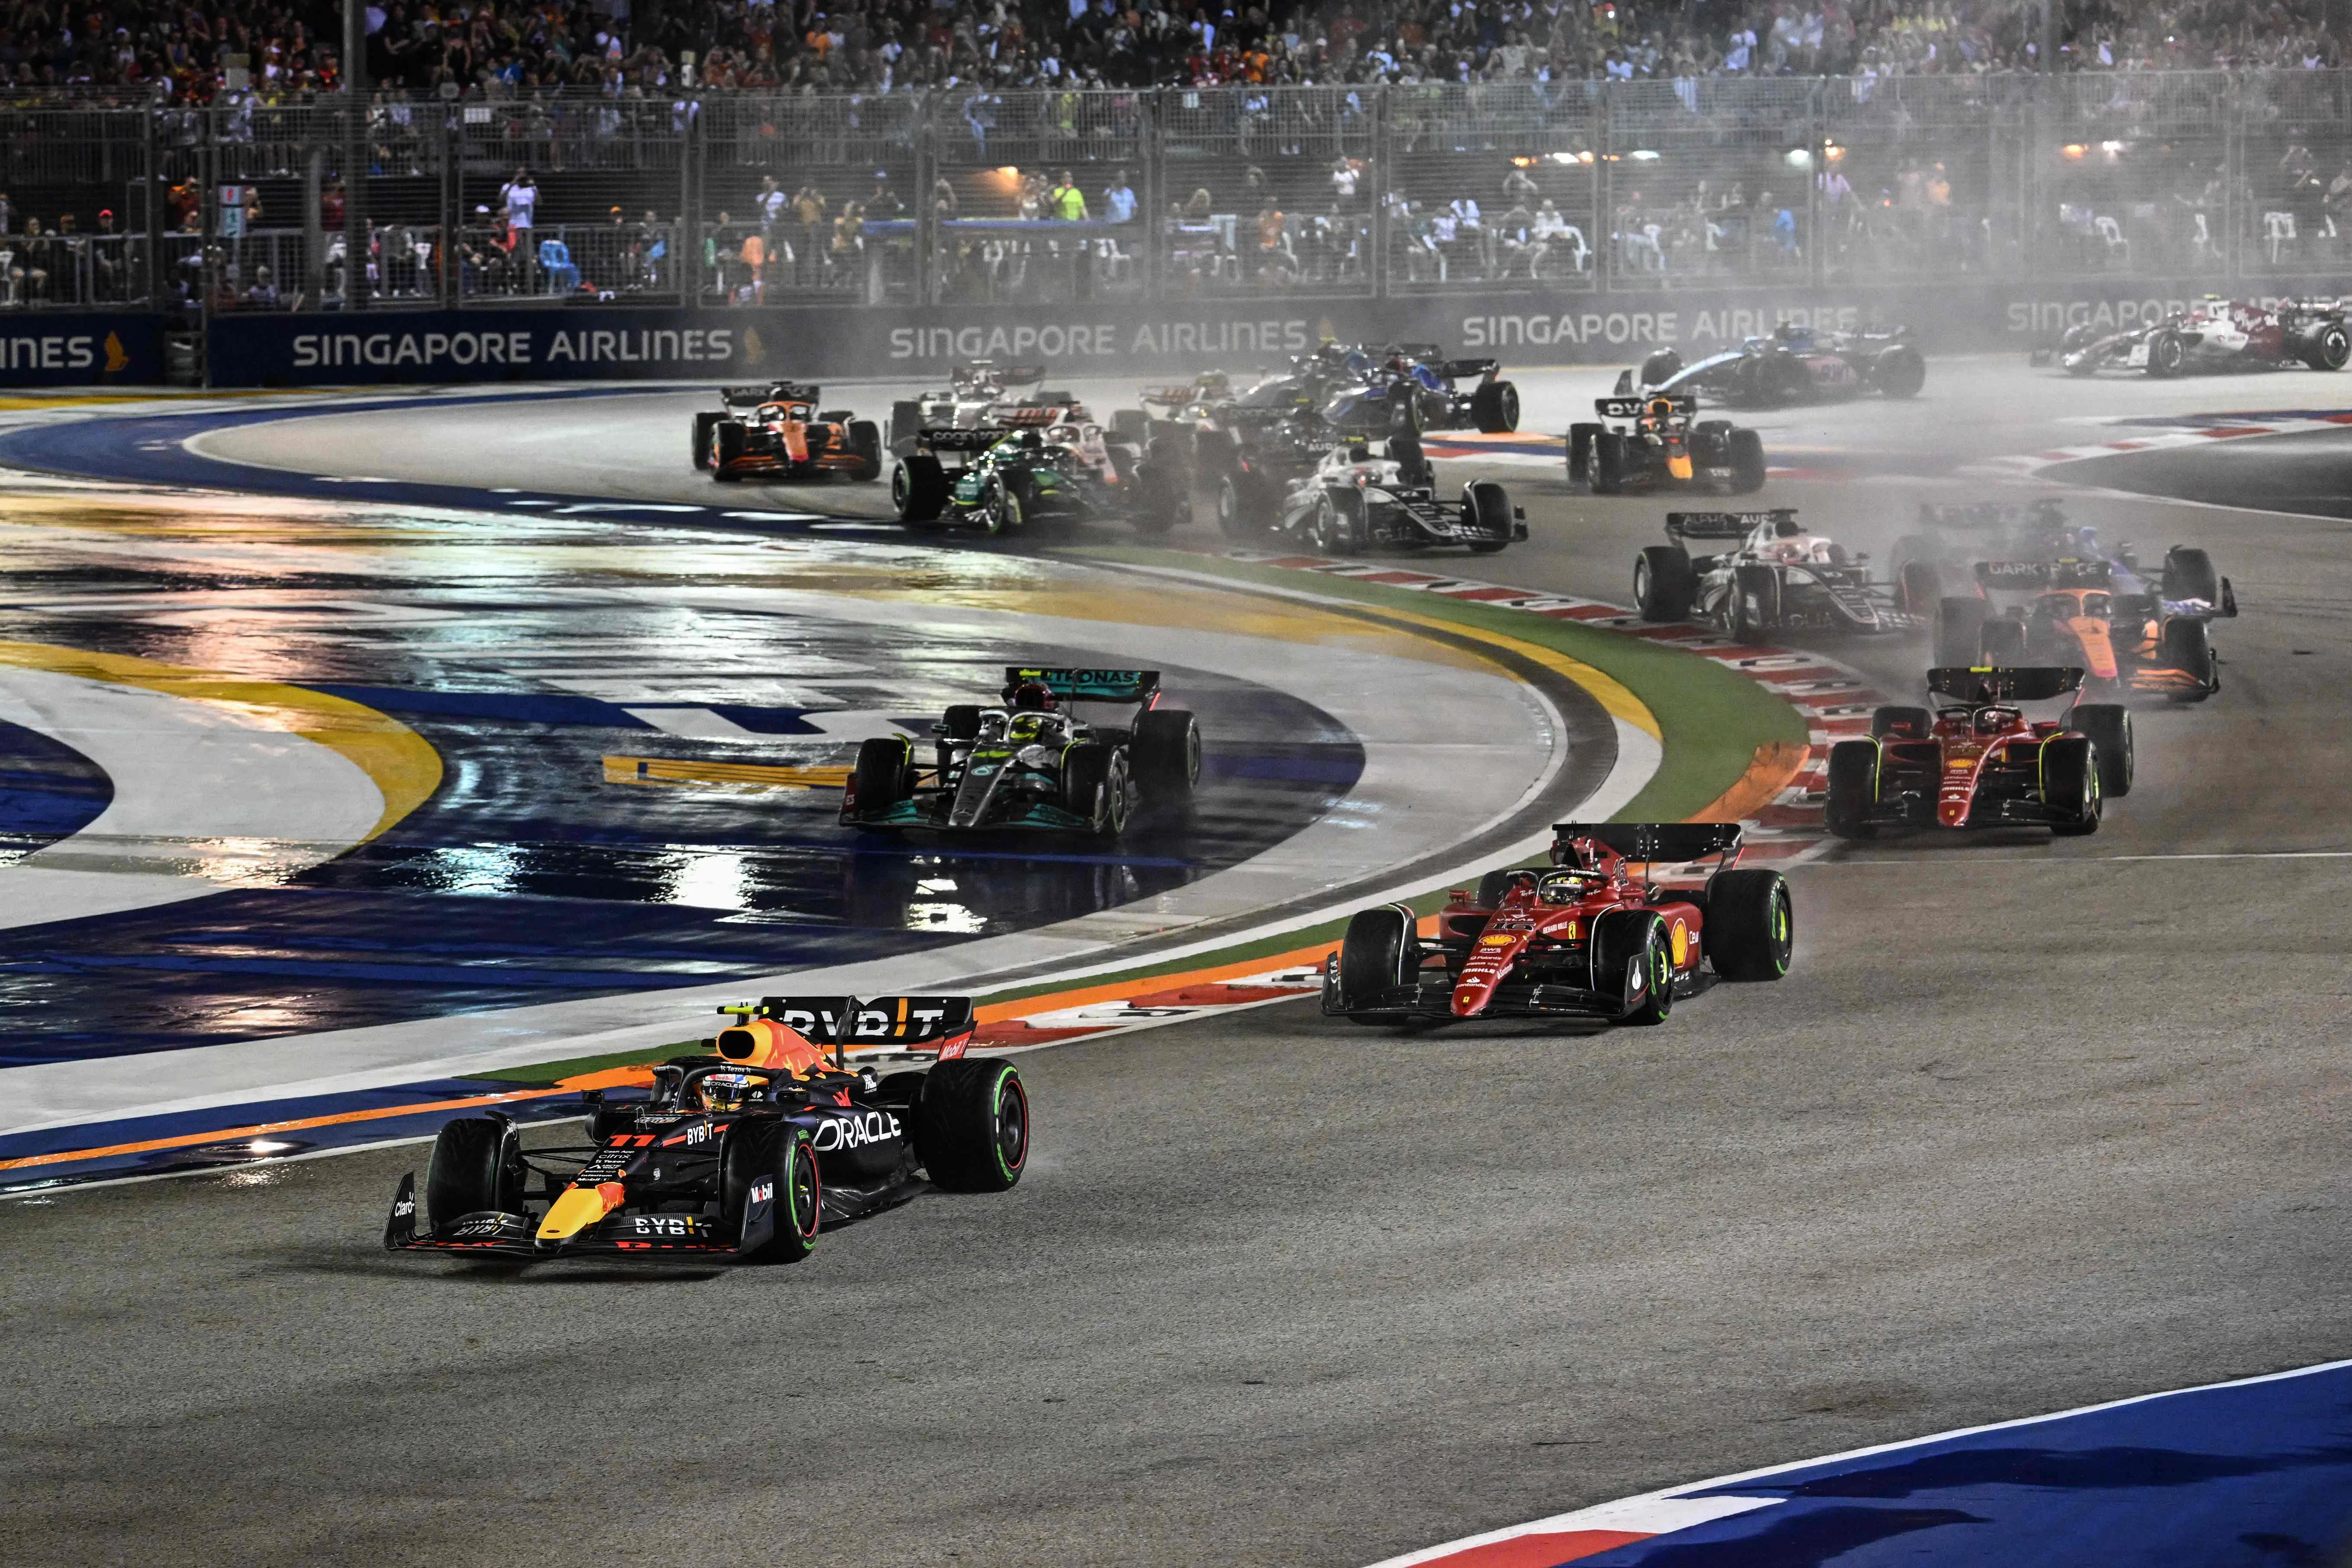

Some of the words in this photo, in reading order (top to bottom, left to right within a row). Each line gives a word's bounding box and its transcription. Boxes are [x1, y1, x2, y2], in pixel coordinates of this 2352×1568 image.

[890, 326, 1115, 358] SINGAPORE
[1132, 320, 1307, 352] AIRLINES
[1463, 312, 1677, 346] SINGAPORE
[293, 332, 531, 366] SINGAPORE
[547, 330, 732, 361] AIRLINES
[1037, 670, 1135, 684] ETRONAS
[939, 1040, 962, 1061] Mobil
[610, 1135, 656, 1146] 11
[687, 1120, 713, 1145] BYBIT
[812, 1111, 901, 1151] ORACLE
[751, 1182, 773, 1203] Mobil
[394, 1200, 413, 1217] Claro
[635, 1215, 712, 1238] BYBIT
